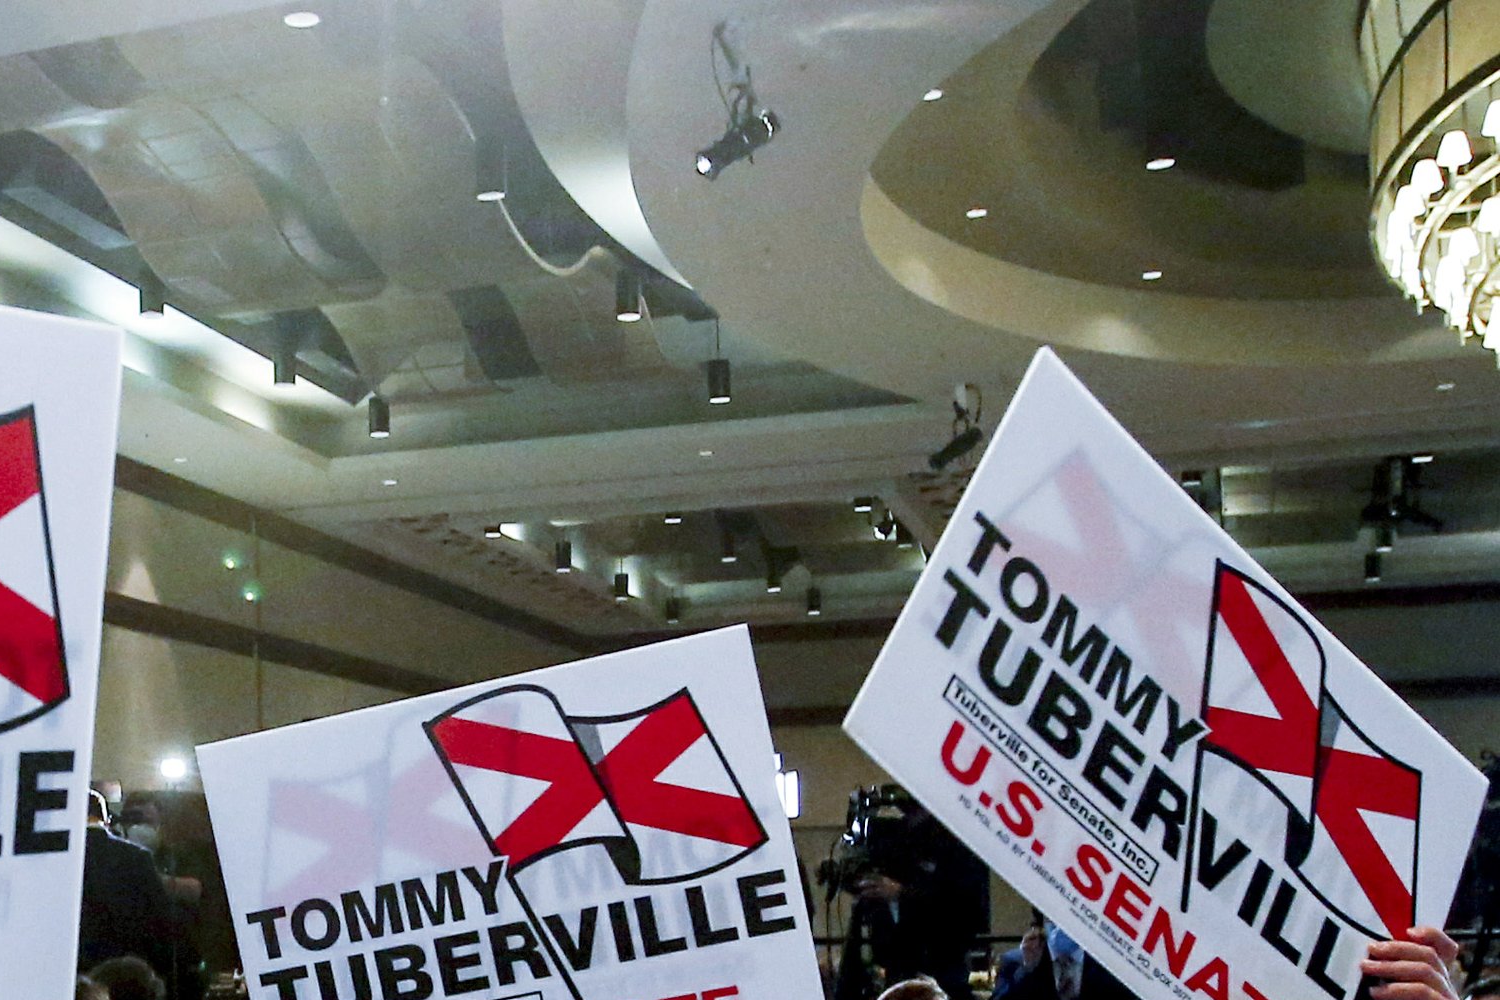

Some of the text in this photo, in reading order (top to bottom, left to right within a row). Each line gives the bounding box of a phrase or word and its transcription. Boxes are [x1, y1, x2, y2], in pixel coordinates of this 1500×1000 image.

[965, 511, 1207, 760] TOMMY
[941, 720, 1046, 857] U.S.
[953, 684, 1150, 875] Tuberville for Senate, Inc.
[245, 860, 504, 960] TOMMY
[1026, 855, 1078, 906] TUBERVILLE
[1080, 903, 1100, 923] FOR
[1152, 967, 1172, 987] BOX
